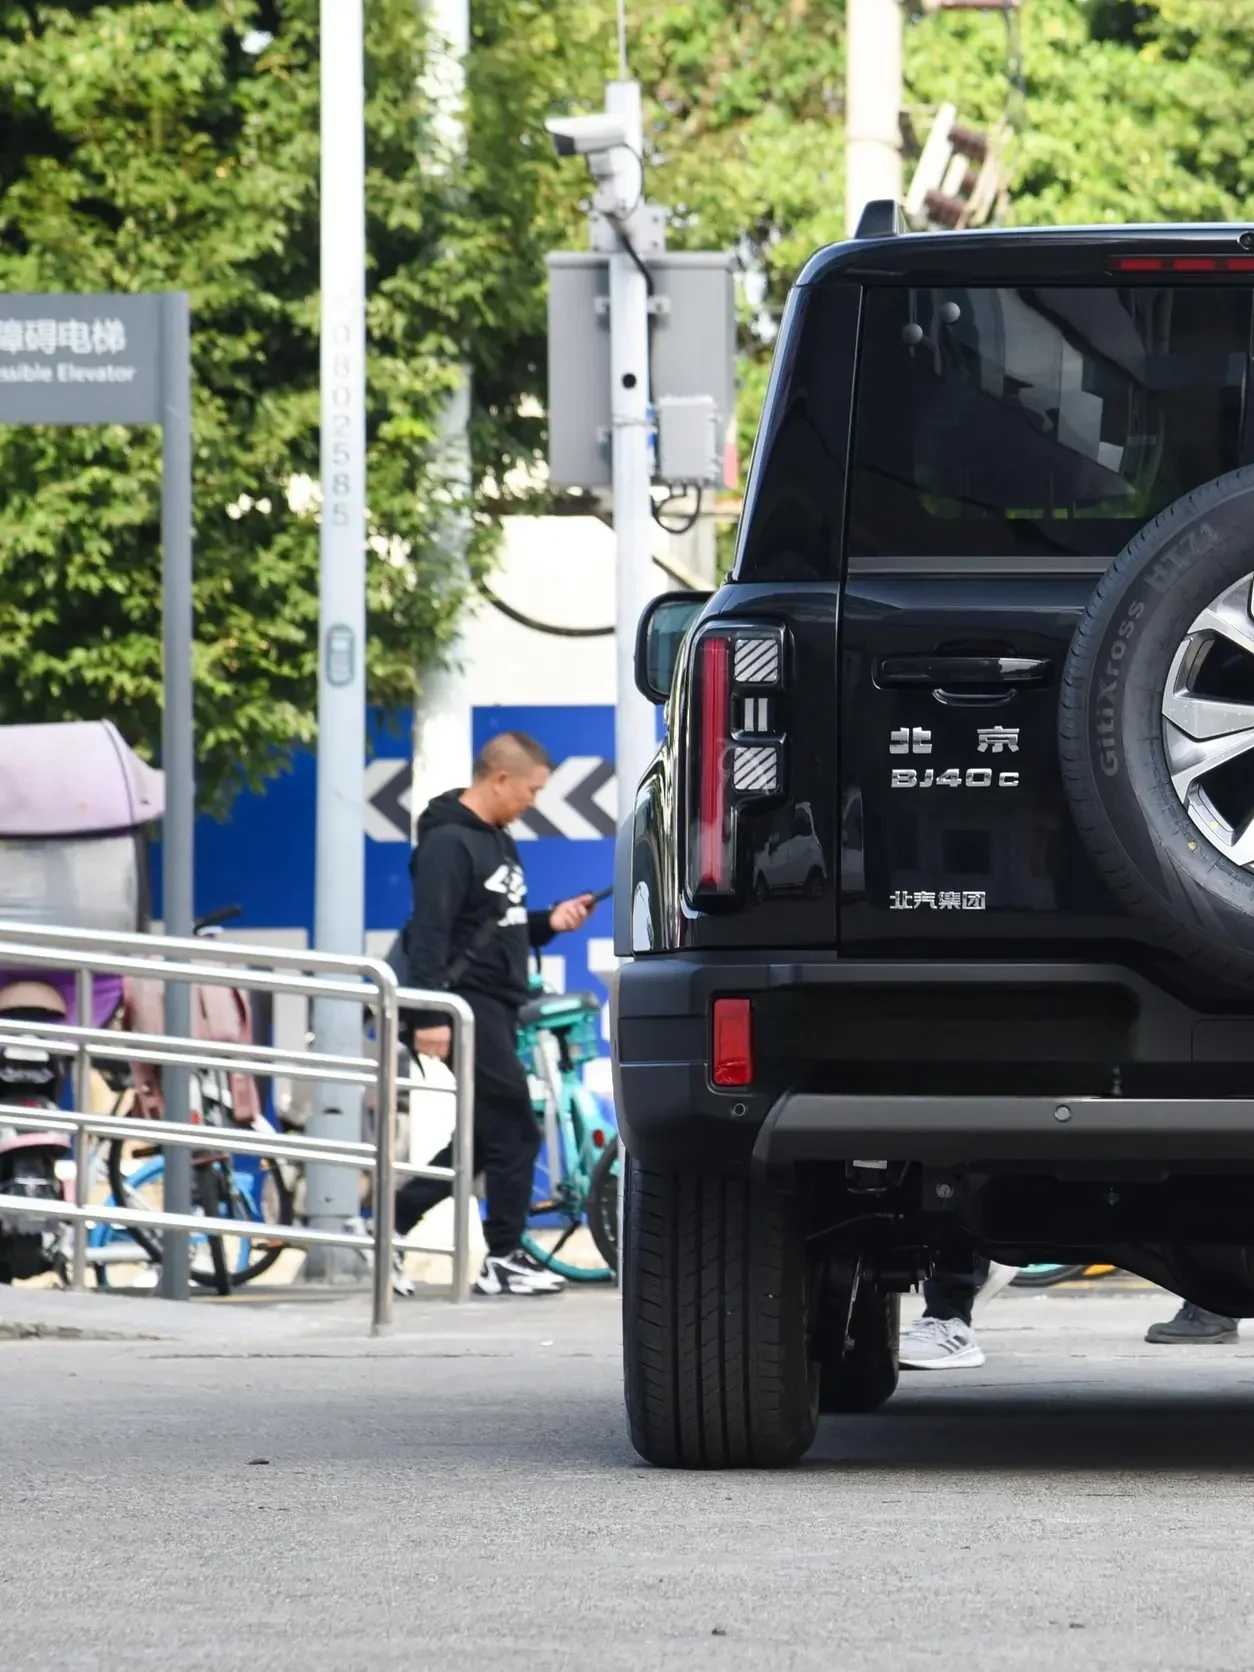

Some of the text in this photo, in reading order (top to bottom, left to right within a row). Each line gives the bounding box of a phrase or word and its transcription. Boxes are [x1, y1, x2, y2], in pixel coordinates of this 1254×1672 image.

[57, 362, 137, 382] Elevator
[1097, 601, 1145, 777] GitiXross
[889, 726, 1020, 754] 北京
[889, 890, 986, 910] 北汽集团
